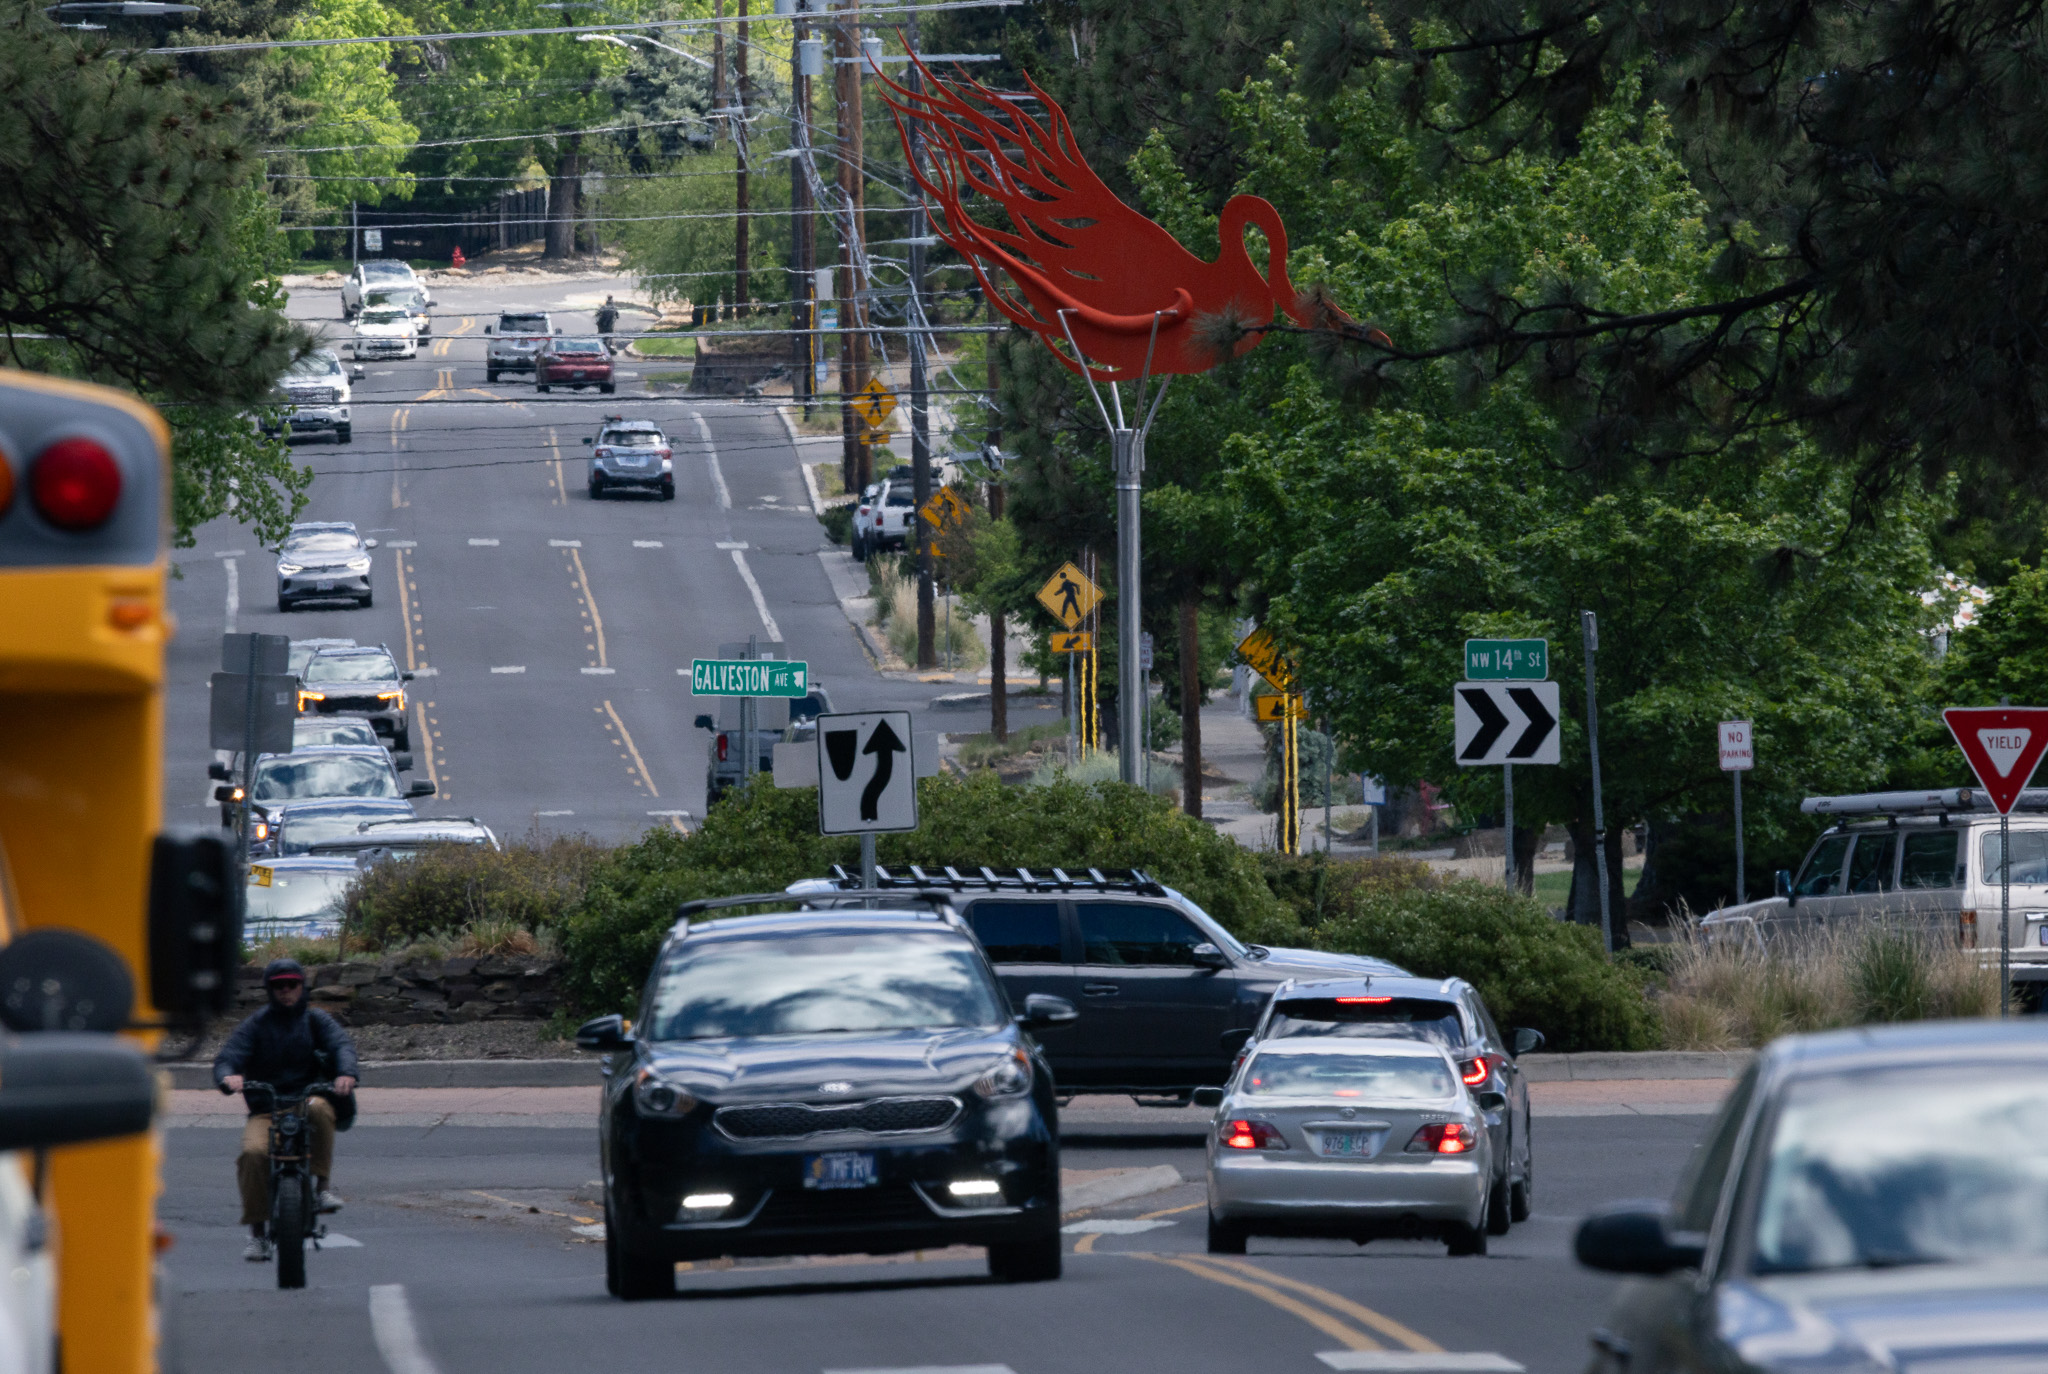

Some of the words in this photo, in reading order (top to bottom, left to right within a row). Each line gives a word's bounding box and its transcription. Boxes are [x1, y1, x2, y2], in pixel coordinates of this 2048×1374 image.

[1471, 652, 1490, 668] NW
[1495, 649, 1522, 670] 14th
[1528, 652, 1541, 667] St
[695, 664, 769, 691] GALVESTON
[775, 673, 788, 687] AVE
[1728, 732, 1743, 743] NO
[1987, 736, 2022, 749] YIELD
[1721, 750, 1752, 758] PARKING
